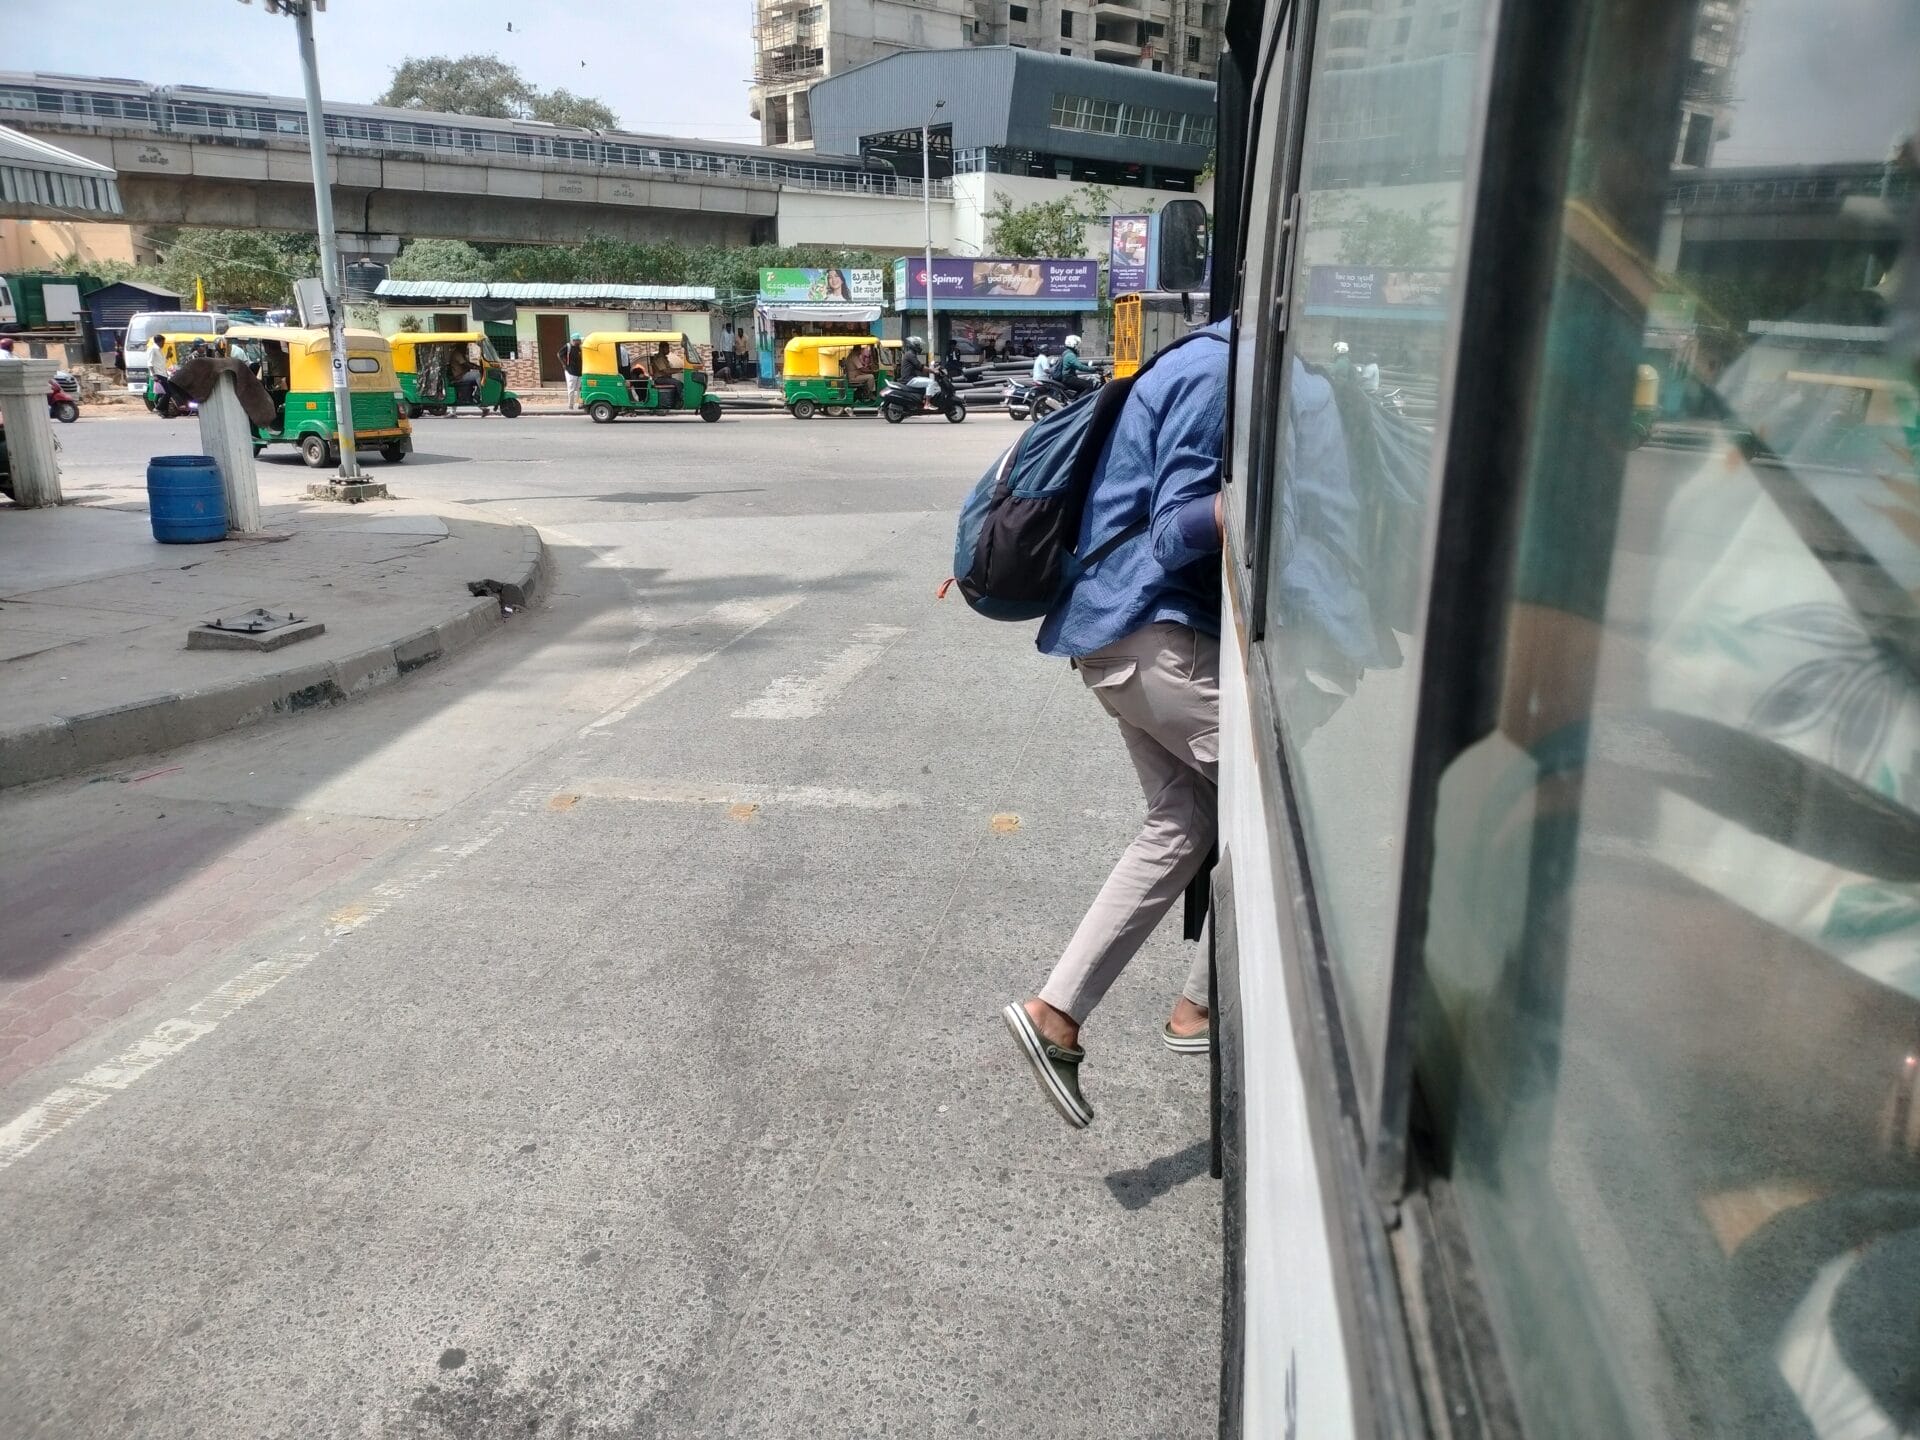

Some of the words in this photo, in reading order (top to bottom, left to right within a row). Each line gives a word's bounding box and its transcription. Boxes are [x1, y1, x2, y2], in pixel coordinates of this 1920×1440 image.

[559, 185, 583, 194] metro
[1050, 266, 1064, 276] Buy
[1075, 266, 1088, 275] sell
[932, 273, 964, 286] Spinny
[1050, 275, 1067, 283] your
